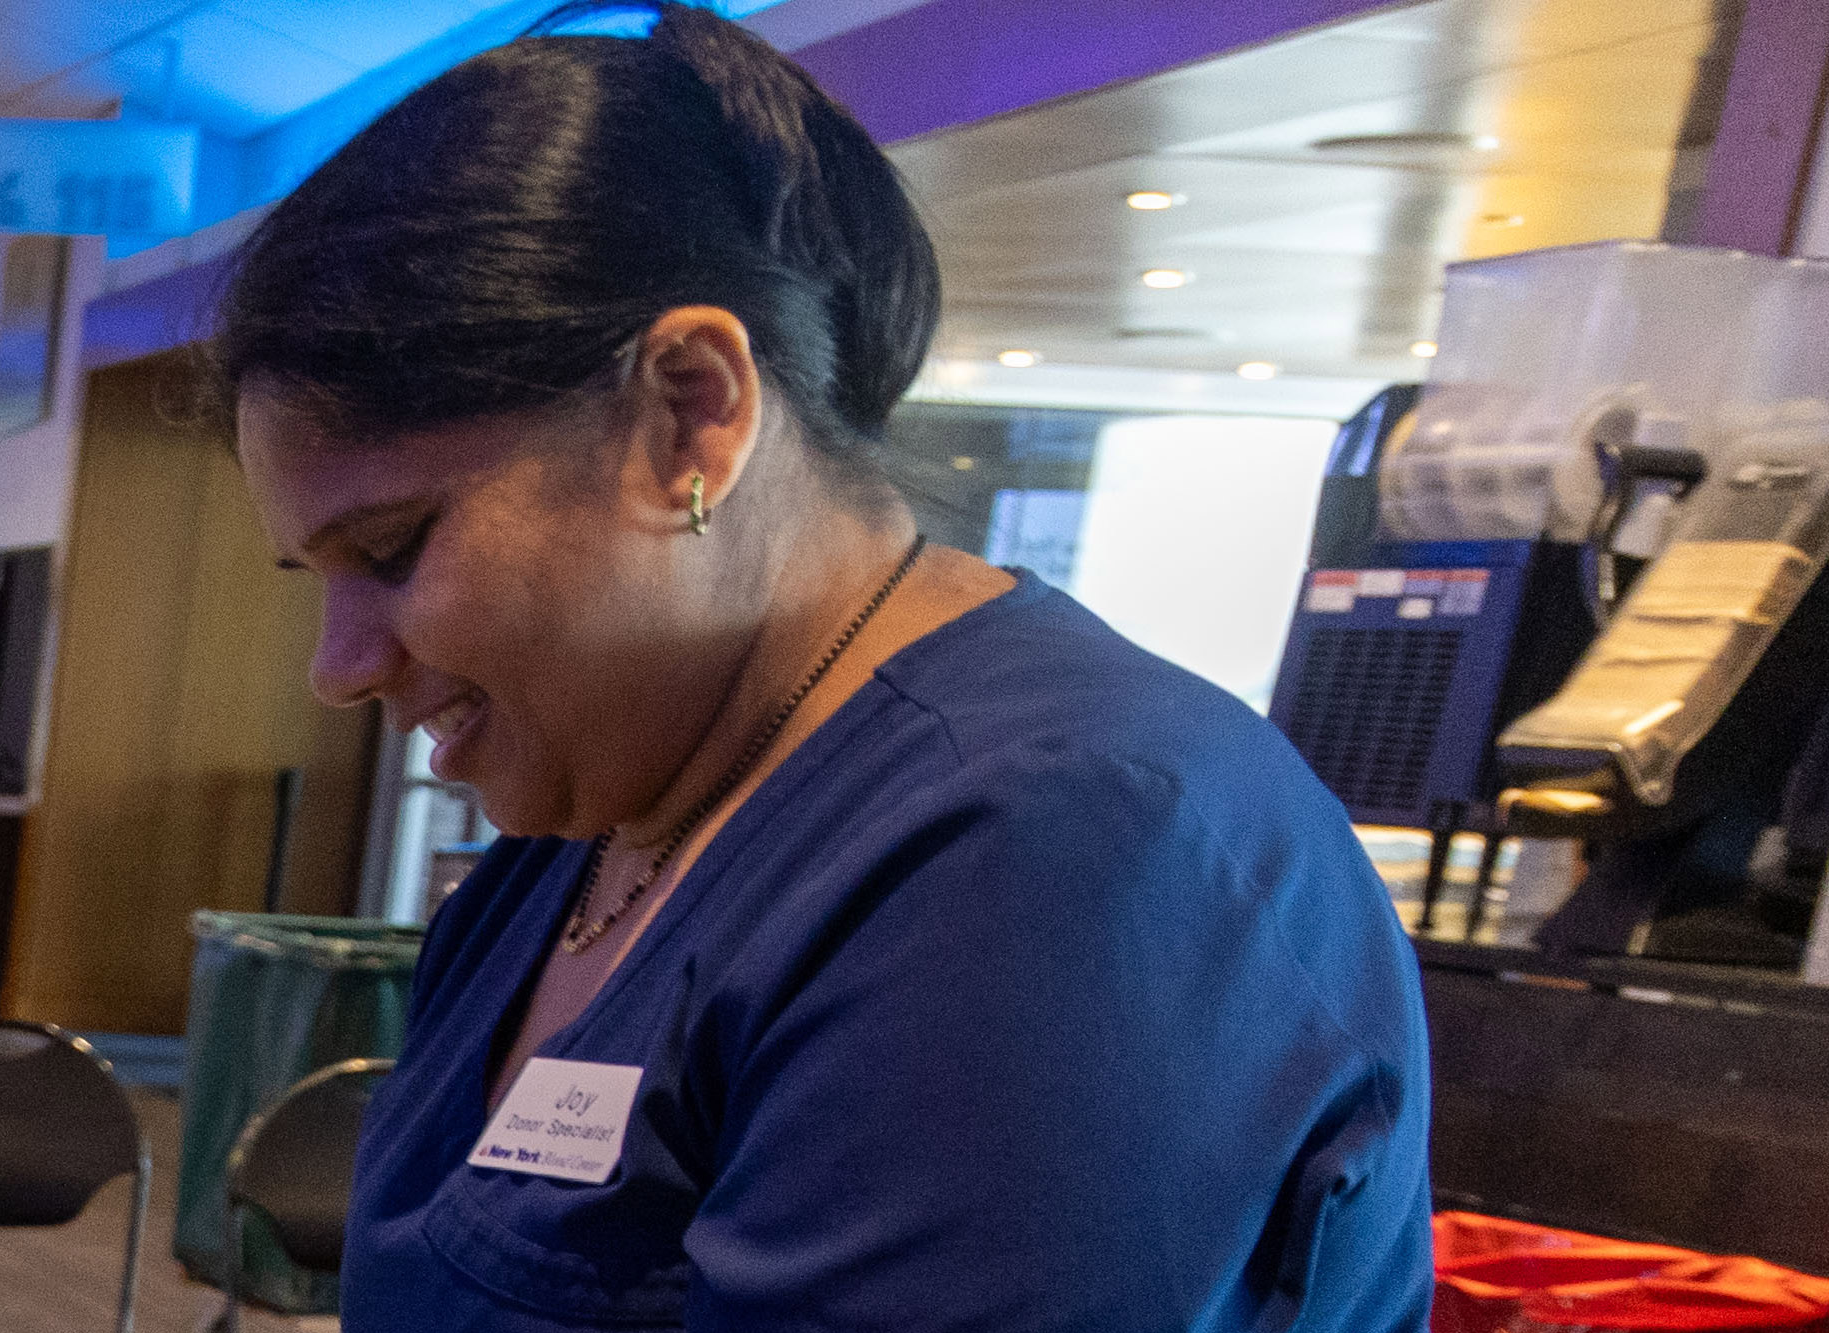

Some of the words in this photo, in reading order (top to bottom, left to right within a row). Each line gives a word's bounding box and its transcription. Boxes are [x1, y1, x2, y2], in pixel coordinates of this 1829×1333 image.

[555, 1085, 599, 1118] Joy
[506, 1113, 543, 1132] Donor
[547, 1118, 617, 1143] Specialist
[488, 1145, 513, 1159] New
[516, 1148, 541, 1163] York
